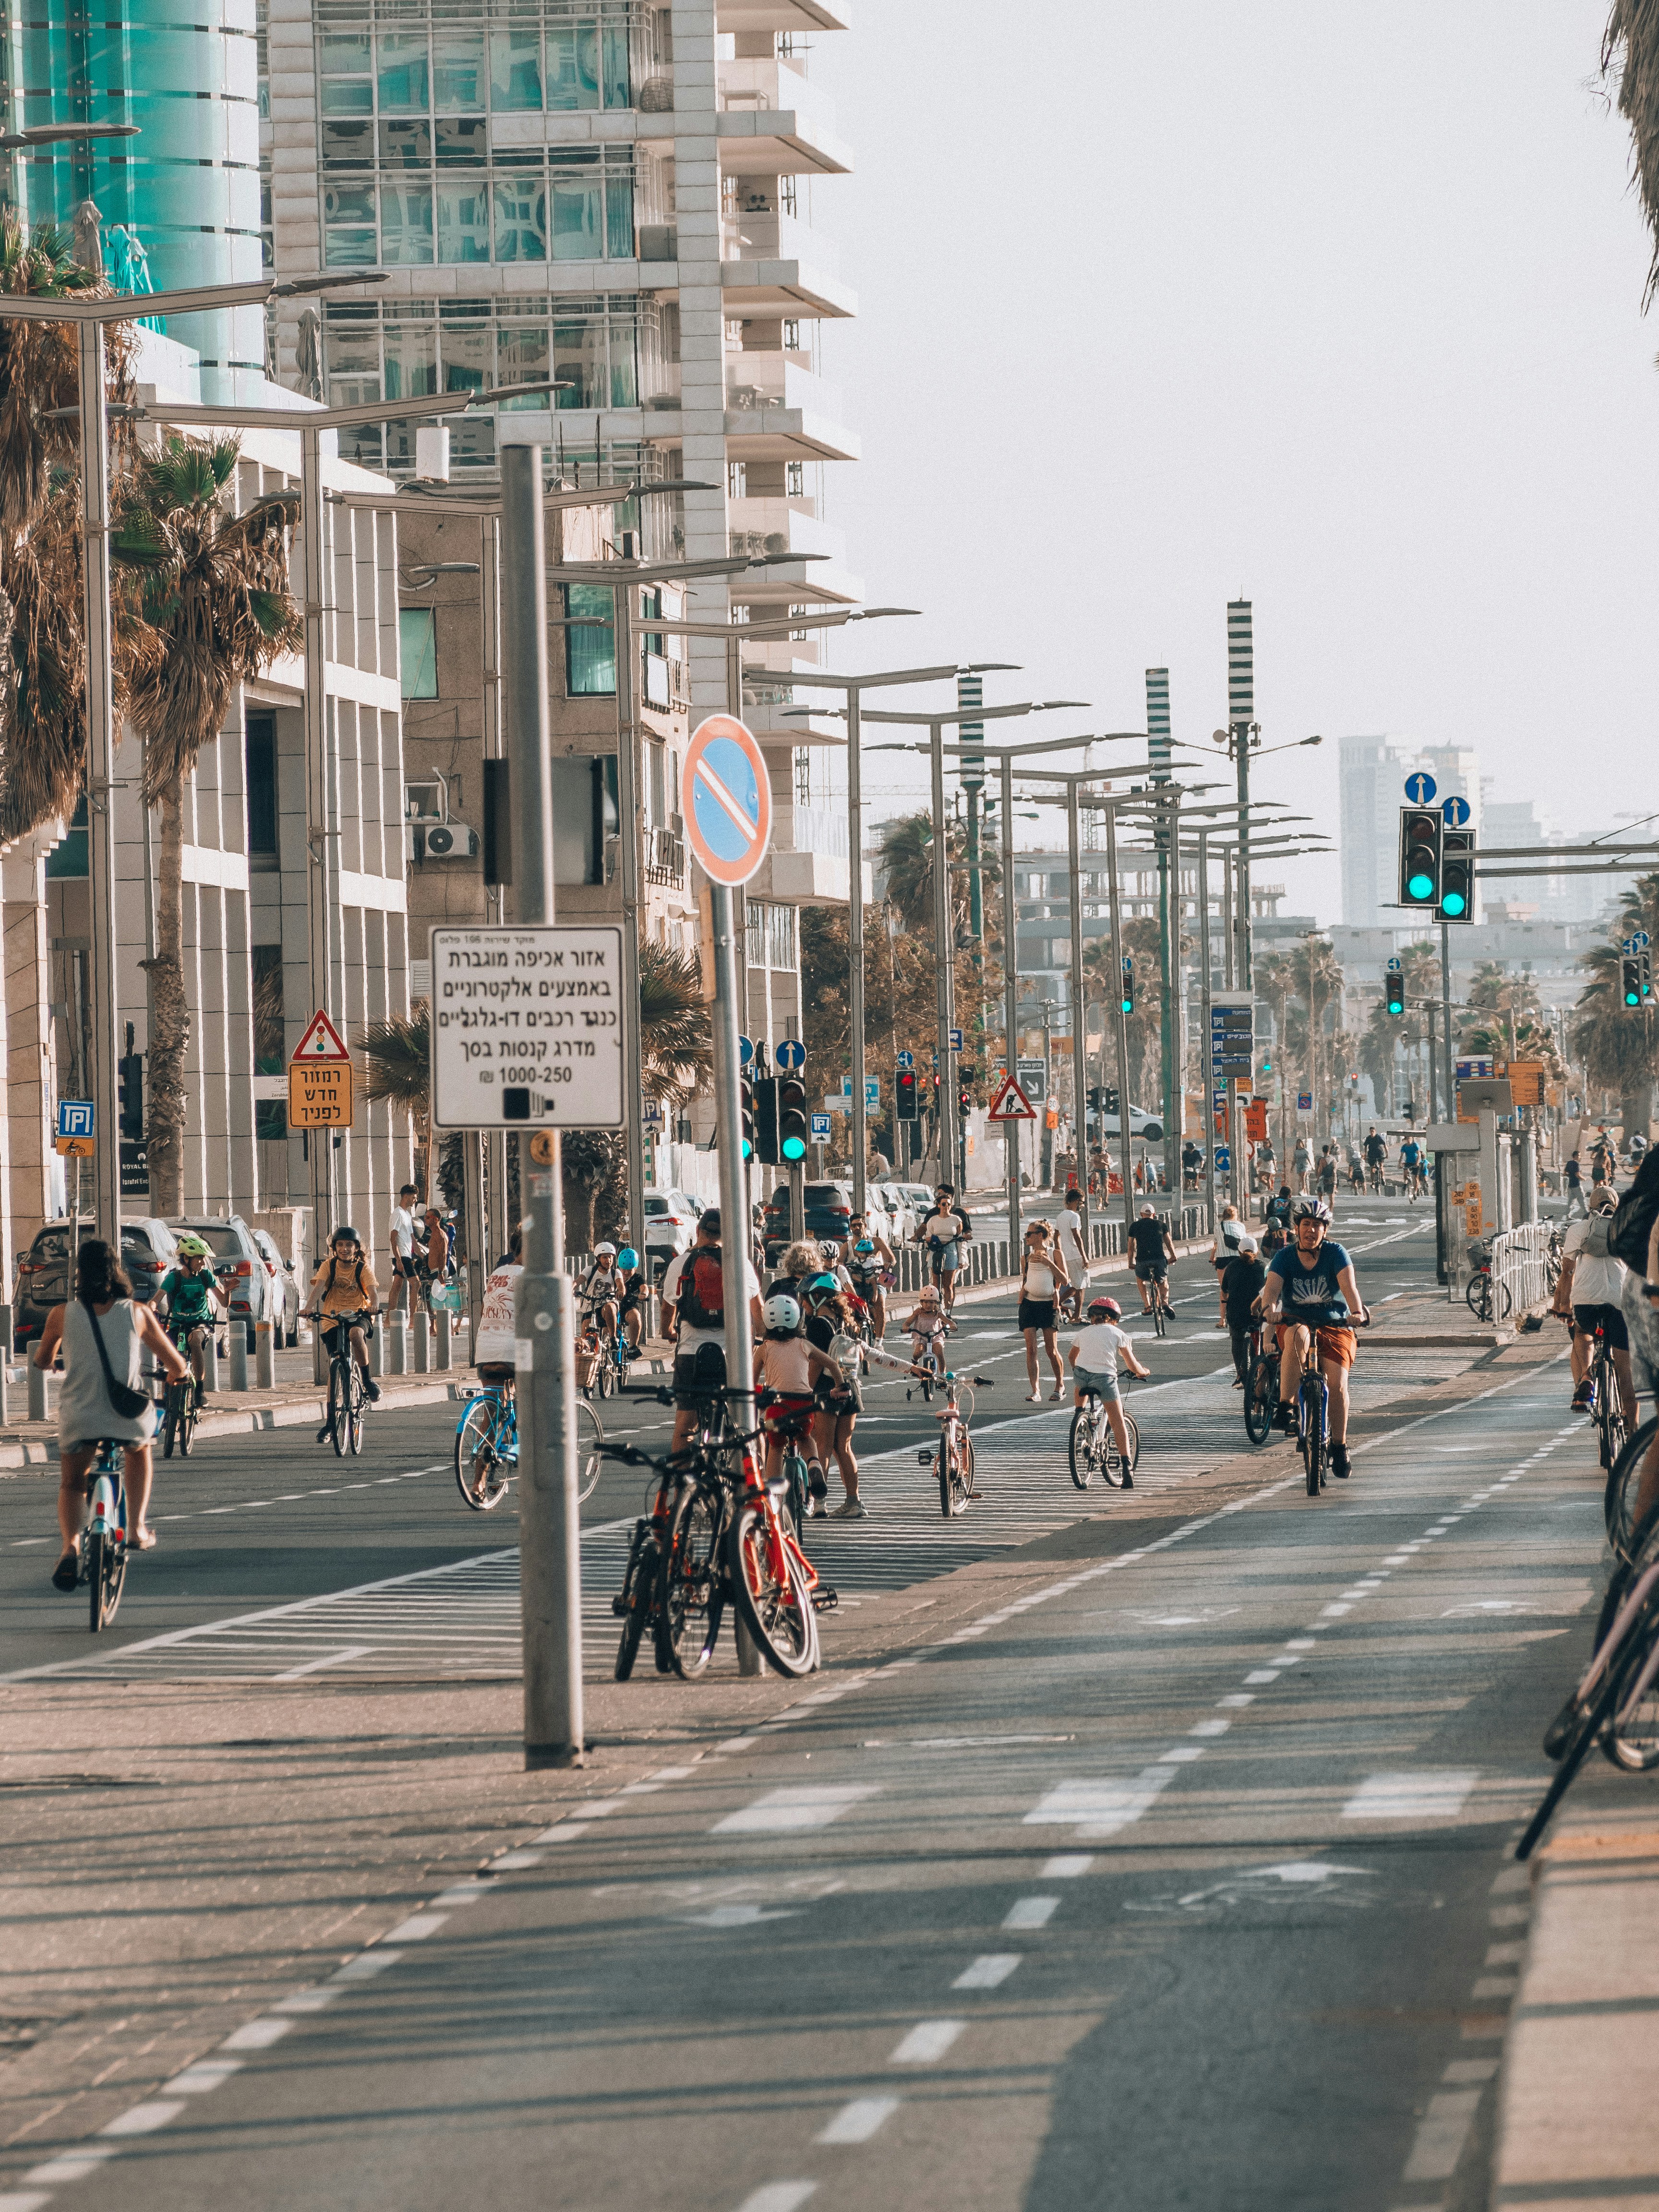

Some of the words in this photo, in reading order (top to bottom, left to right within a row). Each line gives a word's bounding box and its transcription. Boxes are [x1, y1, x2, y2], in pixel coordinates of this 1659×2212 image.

[448, 951, 508, 967] מוגברת
[515, 951, 564, 967] אכיפה
[570, 951, 605, 966] אזור
[443, 976, 532, 1002] אלקטרוניים
[539, 981, 611, 998] באמצעים
[439, 1006, 520, 1028] דו-גלגליים
[526, 1011, 574, 1027] רכבים
[580, 1011, 616, 1027] כנגד
[460, 1041, 493, 1062] בסך
[499, 1041, 547, 1062] קנסות
[553, 1041, 595, 1056] מדרג
[301, 1070, 340, 1083] רמזור
[500, 1066, 572, 1083] 1000-250
[305, 1089, 337, 1101] חדש
[301, 1105, 341, 1121] לפניך
